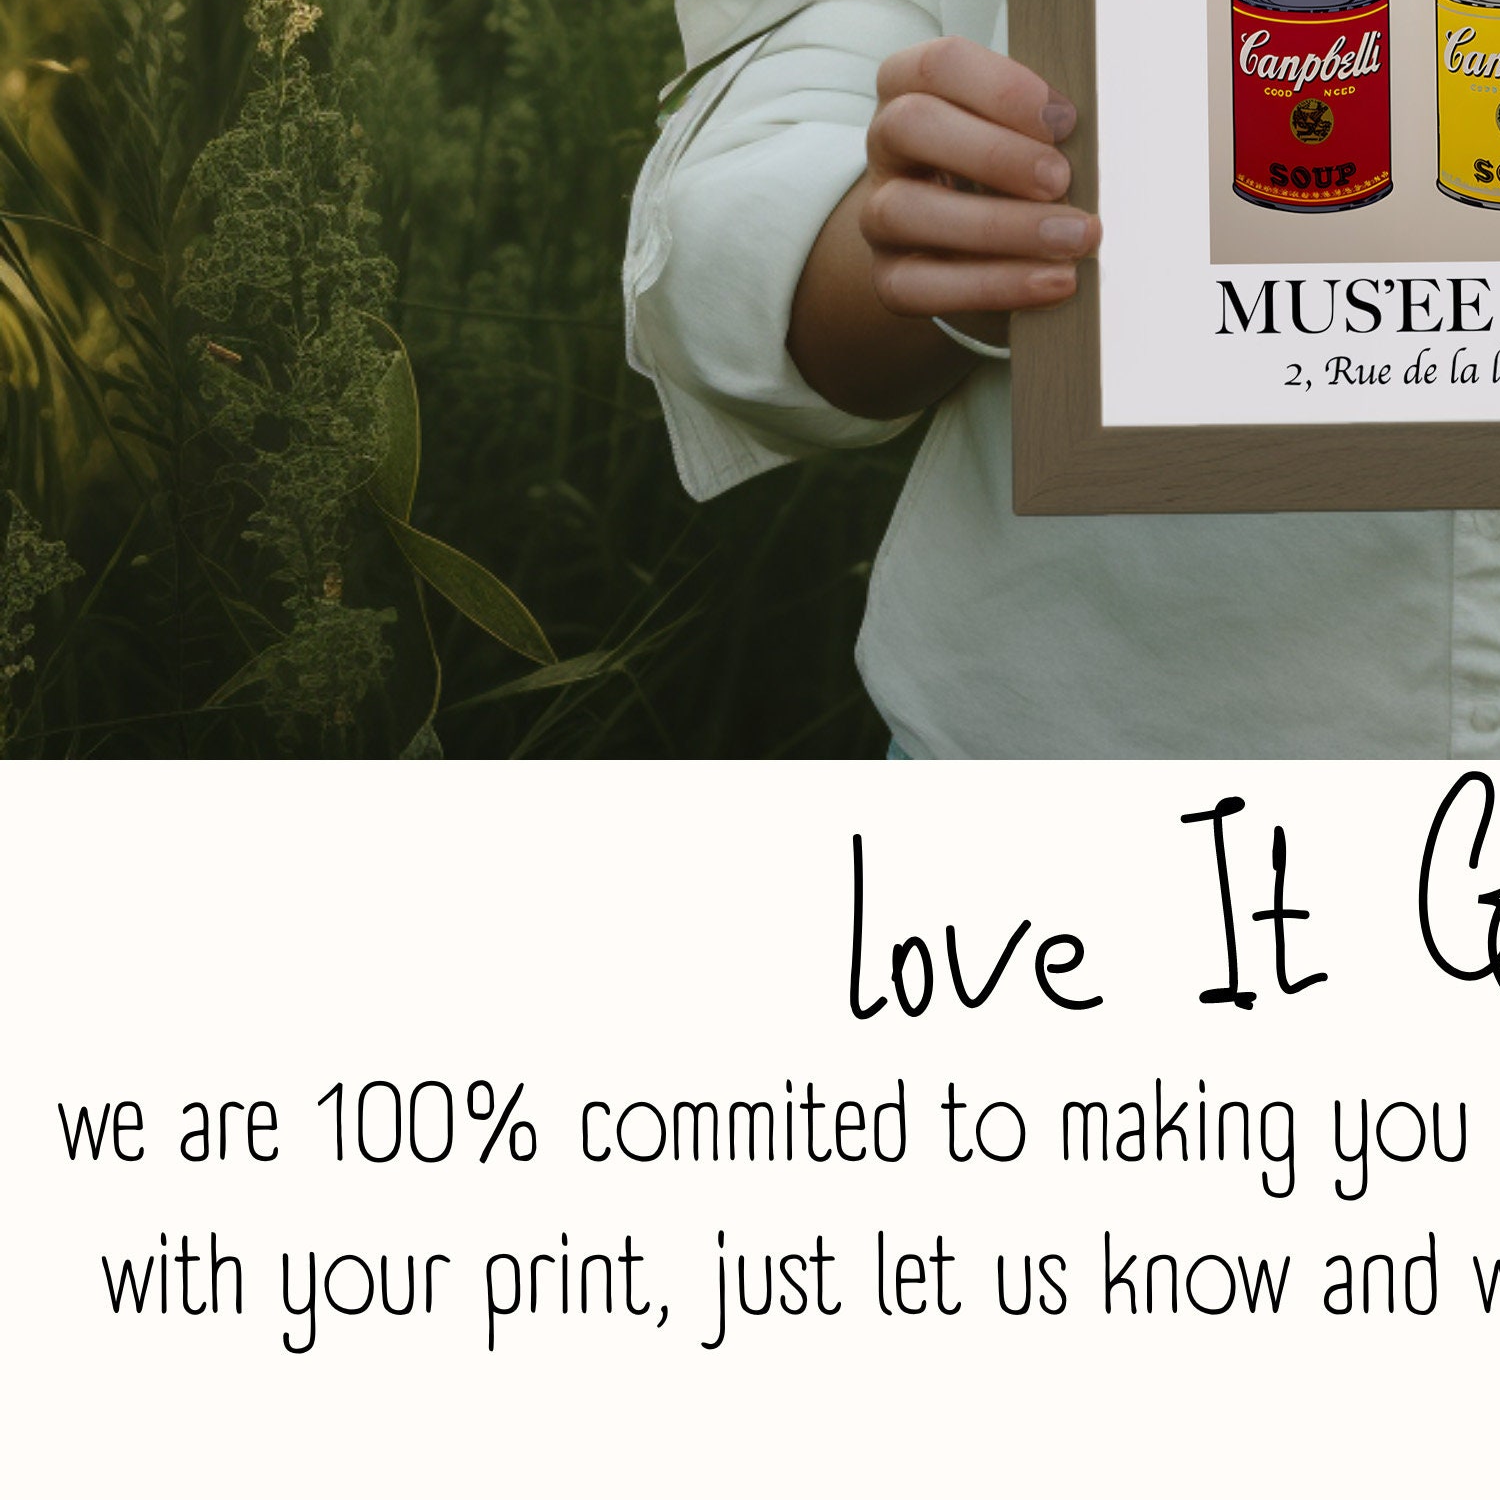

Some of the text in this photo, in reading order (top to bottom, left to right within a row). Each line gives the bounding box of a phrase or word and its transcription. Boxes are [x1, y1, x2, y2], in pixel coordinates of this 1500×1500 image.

[1270, 162, 1356, 189] SOUP
[1216, 279, 1493, 334] MUS'EE
[1285, 364, 1311, 392] 2,
[1326, 356, 1391, 384] Rue
[1404, 348, 1436, 384] de
[1451, 348, 1479, 383] la
